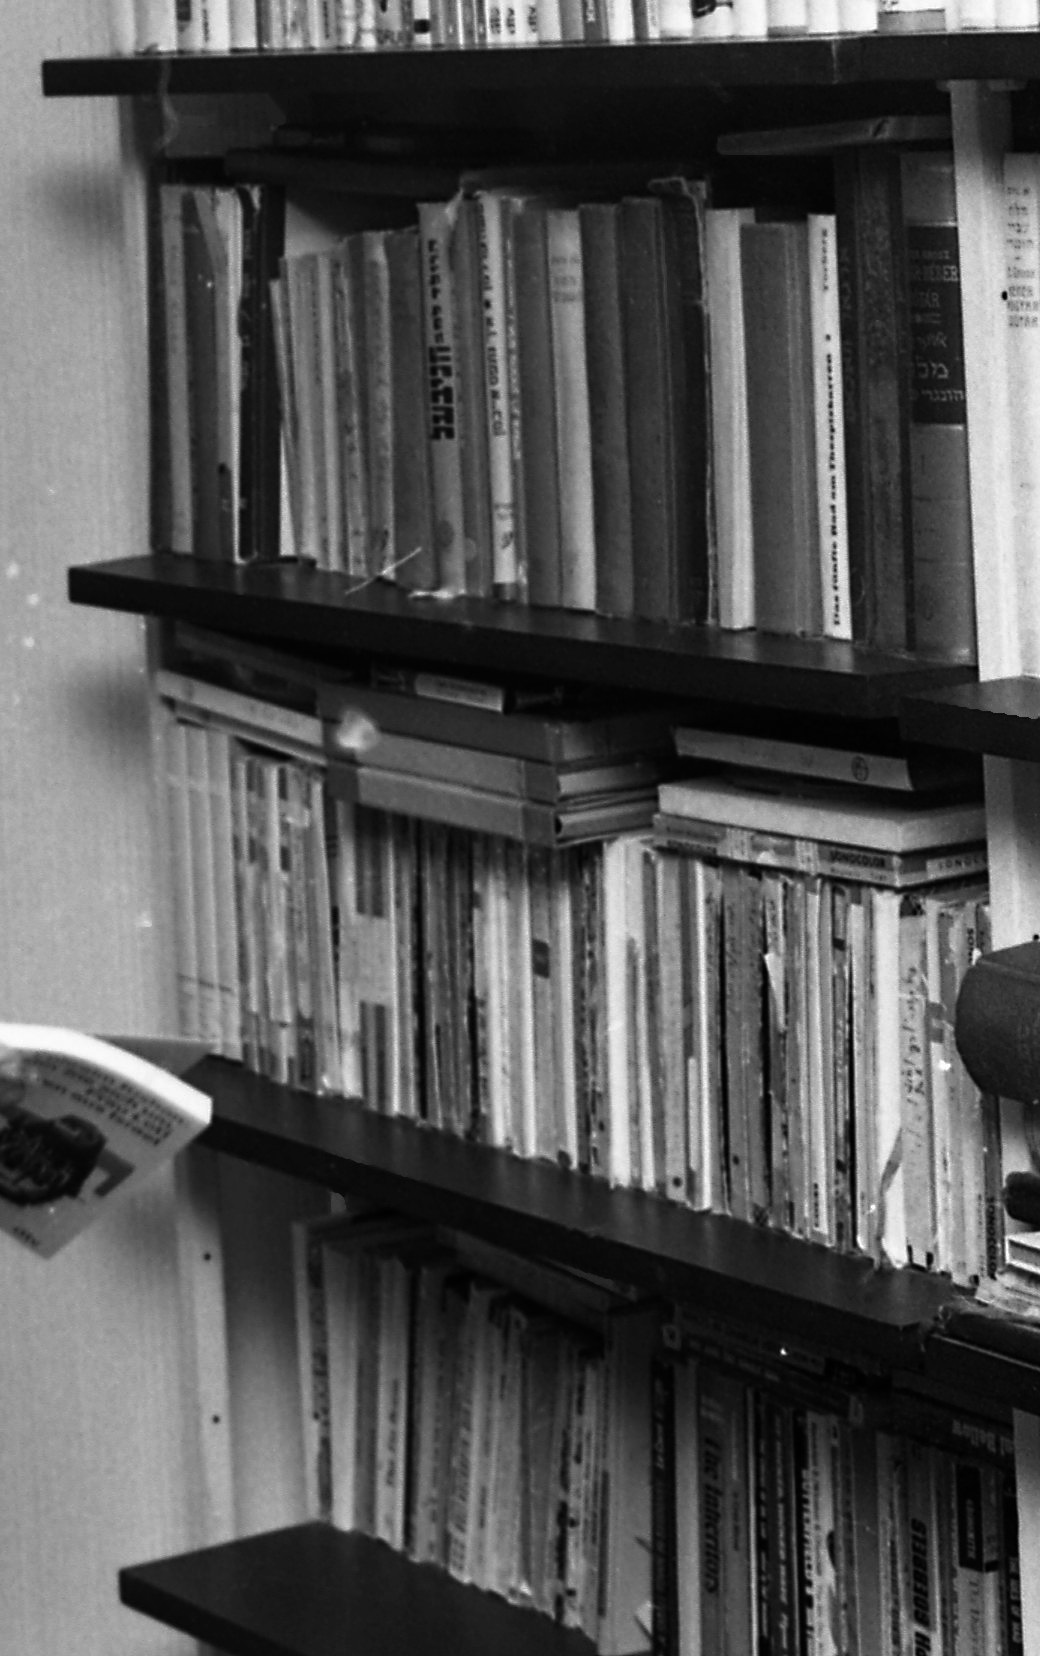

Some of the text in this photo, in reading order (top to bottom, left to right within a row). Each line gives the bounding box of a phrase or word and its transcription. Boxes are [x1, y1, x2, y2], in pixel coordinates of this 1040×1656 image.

[820, 227, 830, 293] Torberg
[826, 353, 836, 472] Thespiskarren
[829, 503, 839, 539] Rad
[831, 541, 840, 593] fünfte
[832, 595, 841, 627] Das
[829, 849, 885, 869] SONOCOLOR
[702, 1437, 723, 1595] The Inheritors
[911, 1517, 930, 1630] GOEBBELS
